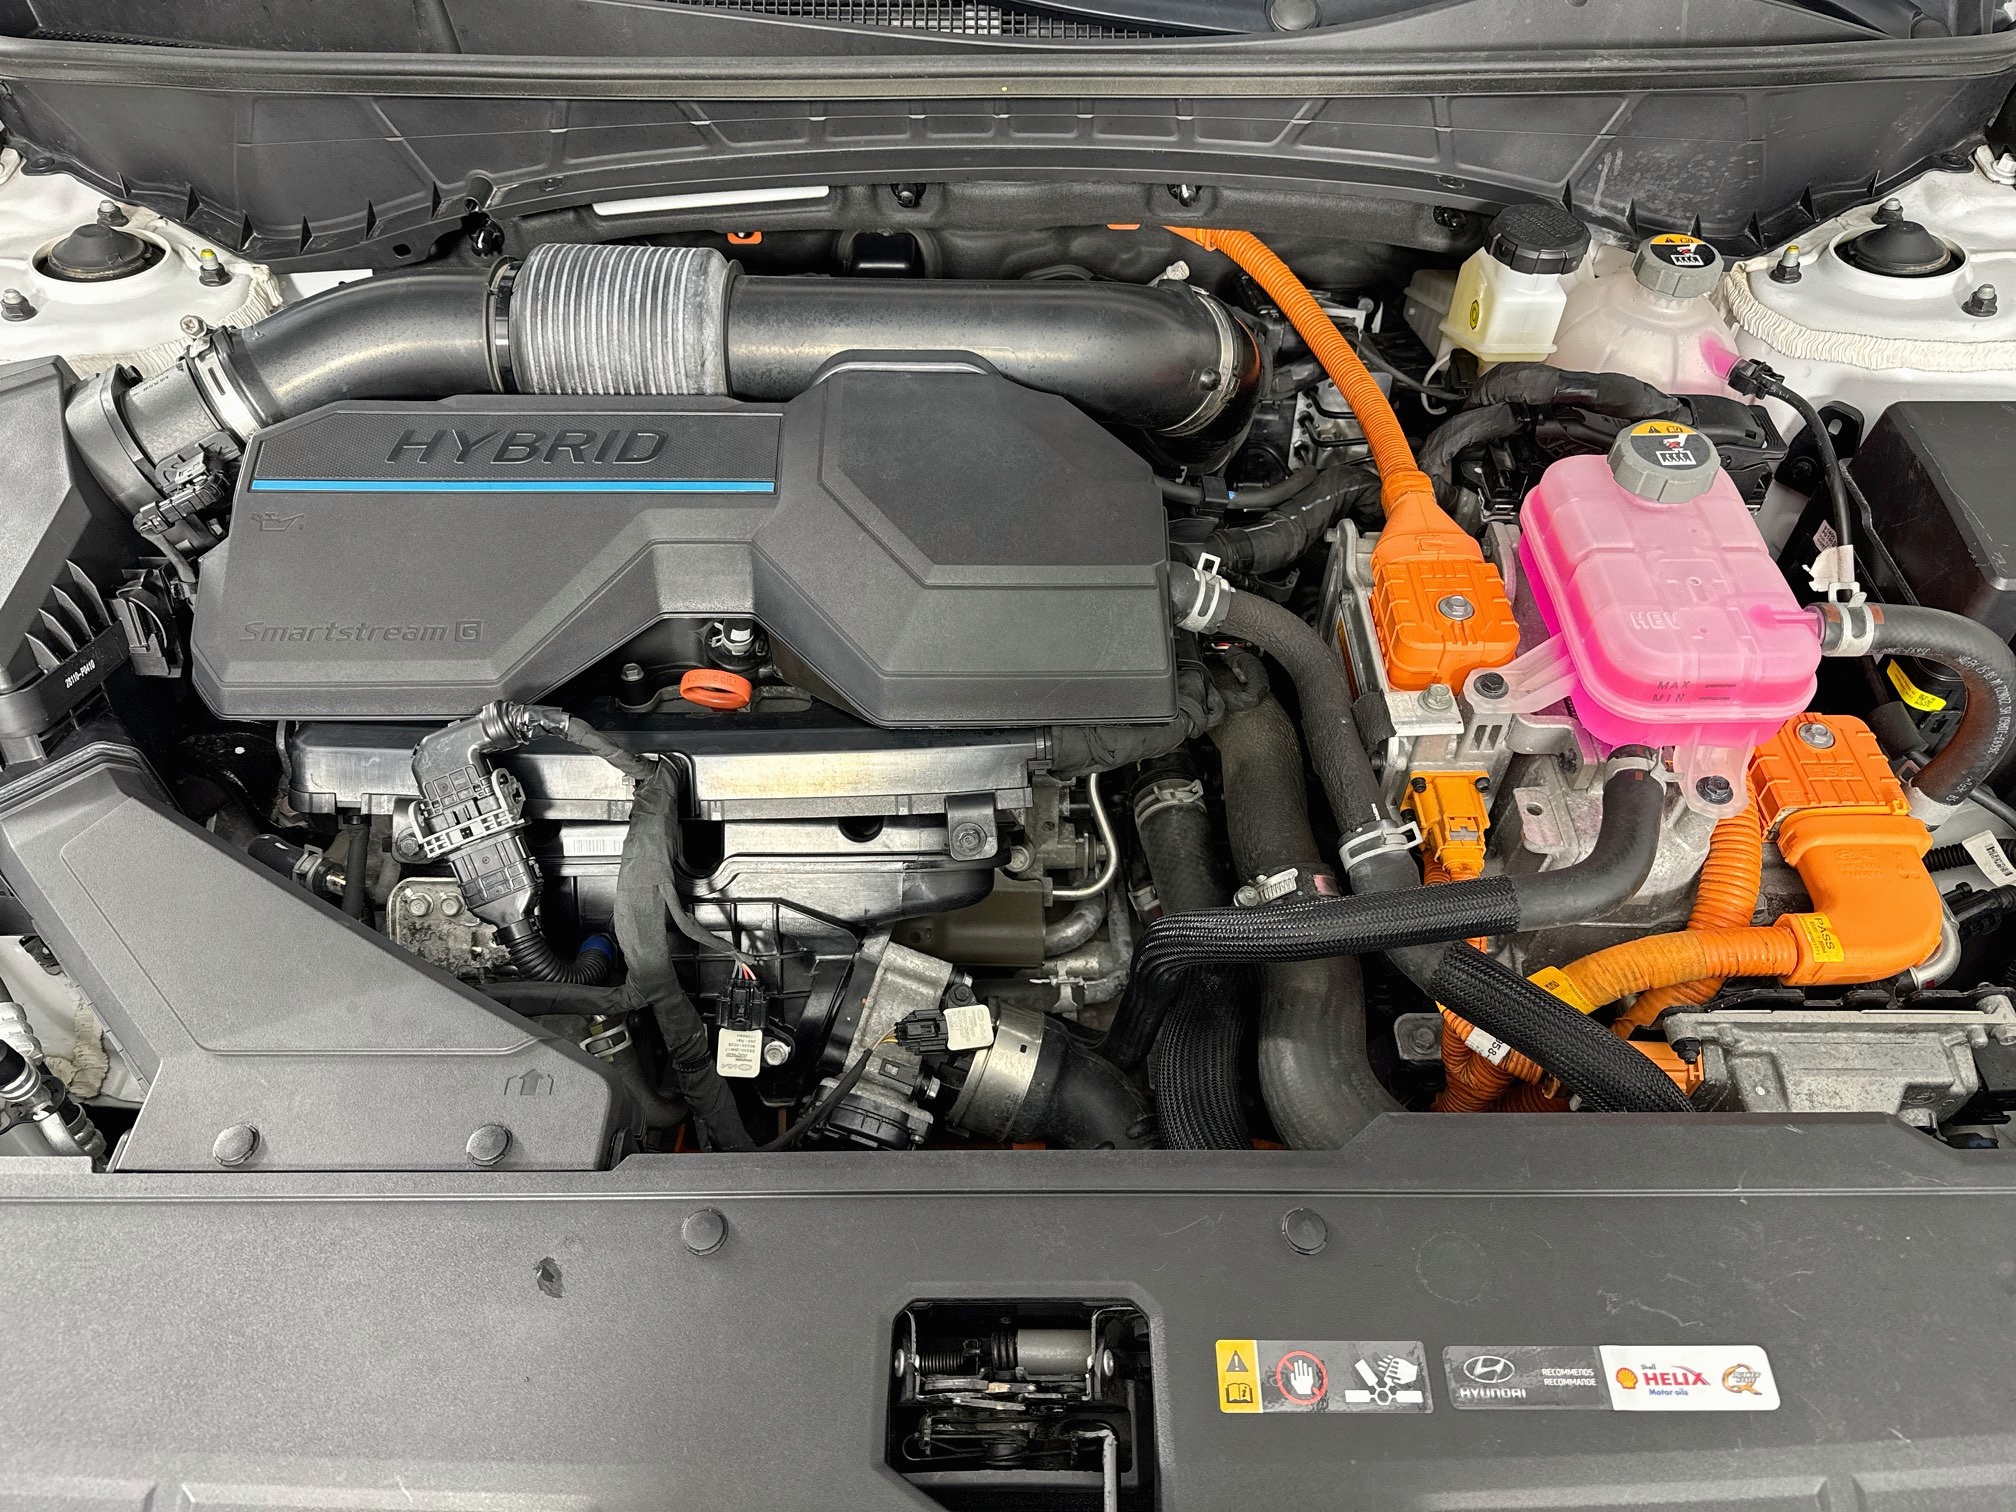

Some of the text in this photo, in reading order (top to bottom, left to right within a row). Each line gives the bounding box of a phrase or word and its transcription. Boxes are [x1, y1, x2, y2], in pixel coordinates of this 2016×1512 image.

[385, 429, 669, 464] HYBRID
[1630, 611, 1680, 630] HEV
[240, 620, 449, 642] Smartstream
[1657, 680, 1690, 690] MAX
[1652, 693, 1685, 703] MIN
[1814, 917, 1835, 950] PASS
[1541, 1368, 1594, 1376] RECOMMENDS
[1543, 1378, 1597, 1386] RECOMMANDE
[1643, 1372, 1711, 1386] HELIX
[1460, 1388, 1526, 1399] HYUNDAI
[1649, 1388, 1689, 1396] Motor oils
